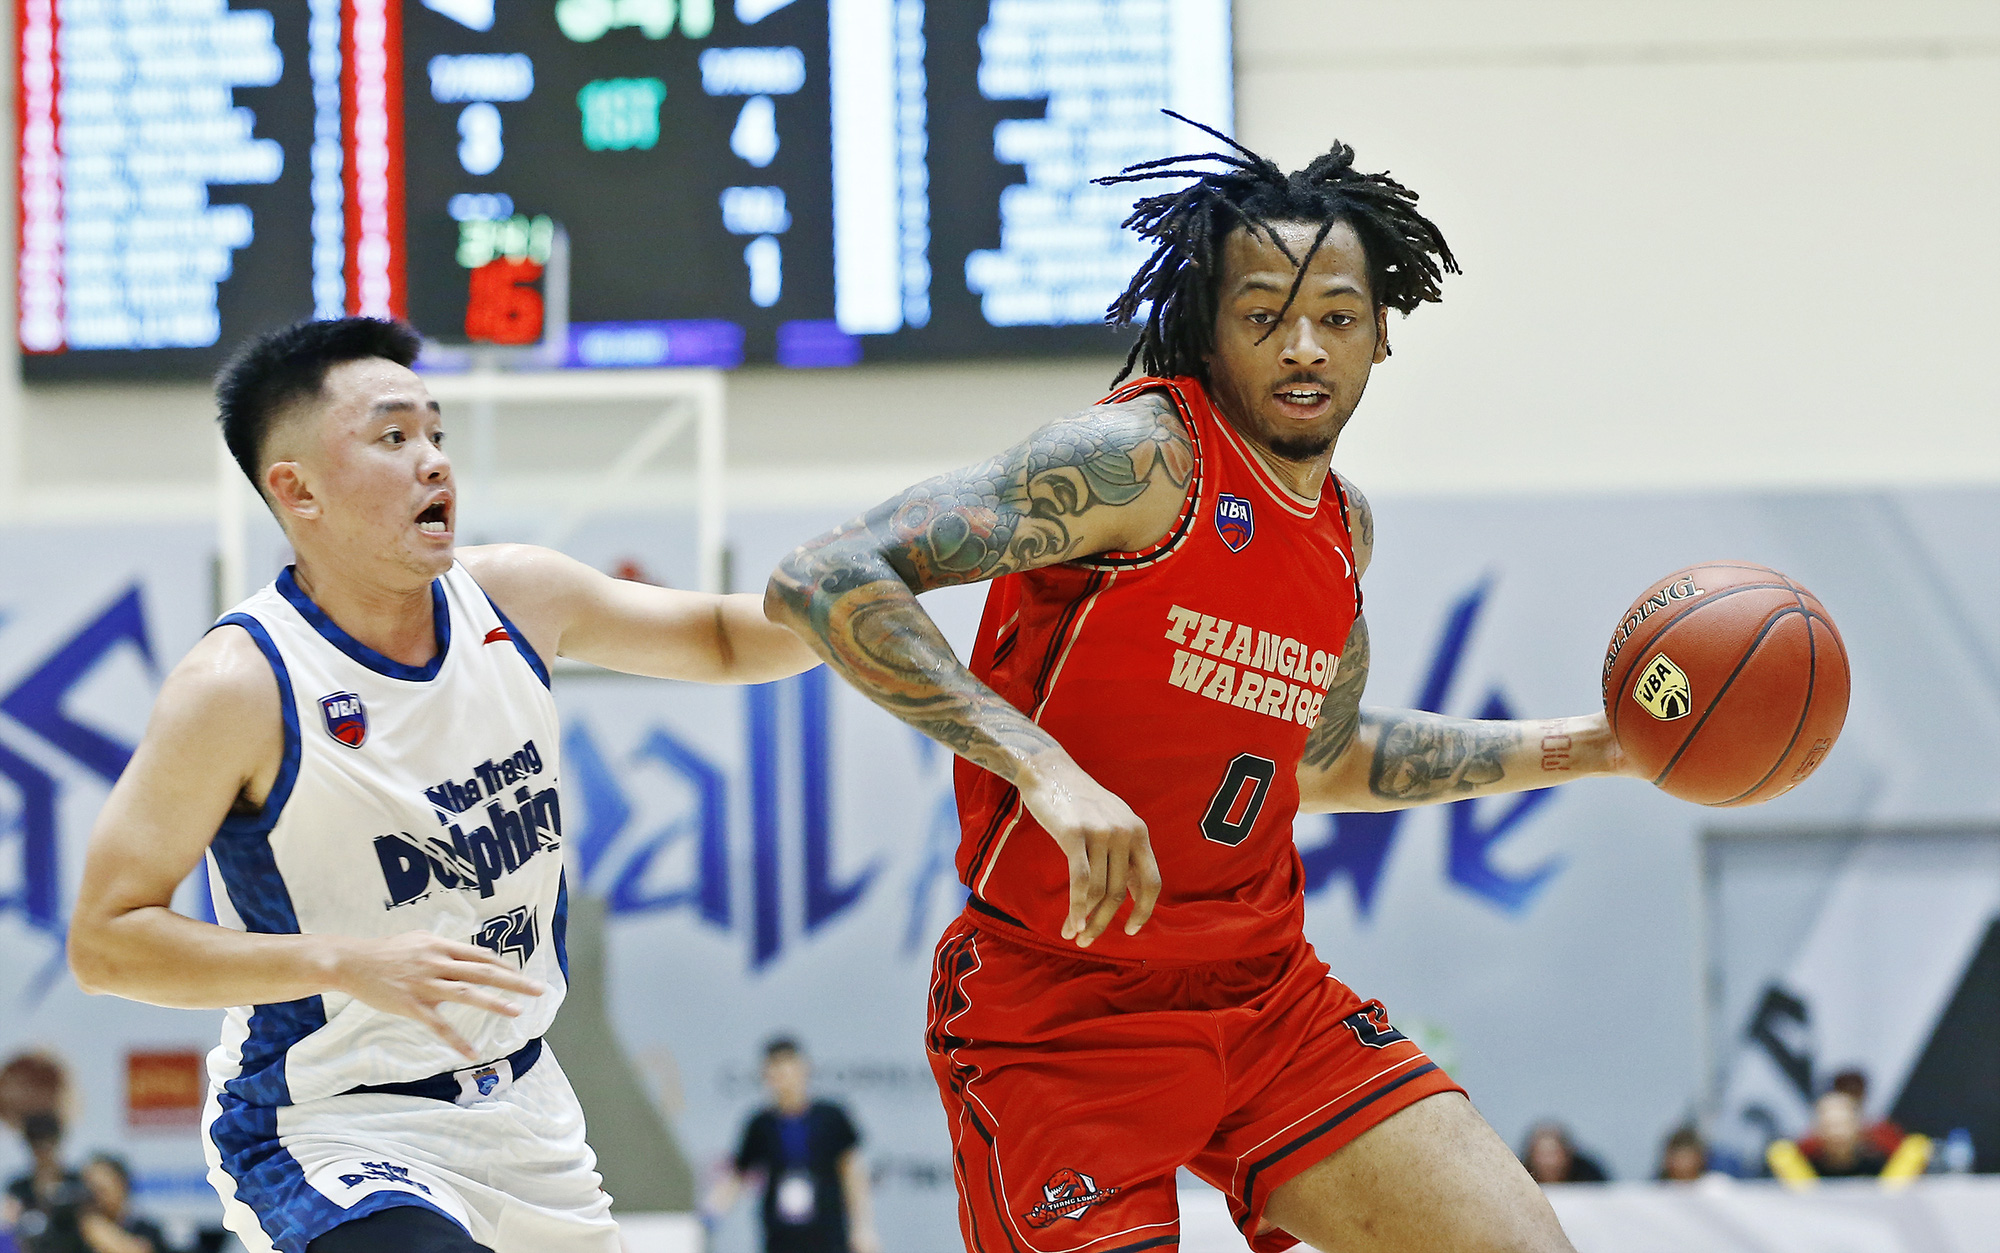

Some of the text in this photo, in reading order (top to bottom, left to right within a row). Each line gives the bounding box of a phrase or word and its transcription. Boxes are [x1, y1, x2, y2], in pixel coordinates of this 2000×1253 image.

[1220, 501, 1248, 522] VBA
[1640, 662, 1672, 703] VBA
[327, 698, 362, 719] VBA
[423, 739, 543, 827] Nha Trang
[1199, 752, 1276, 847] 0
